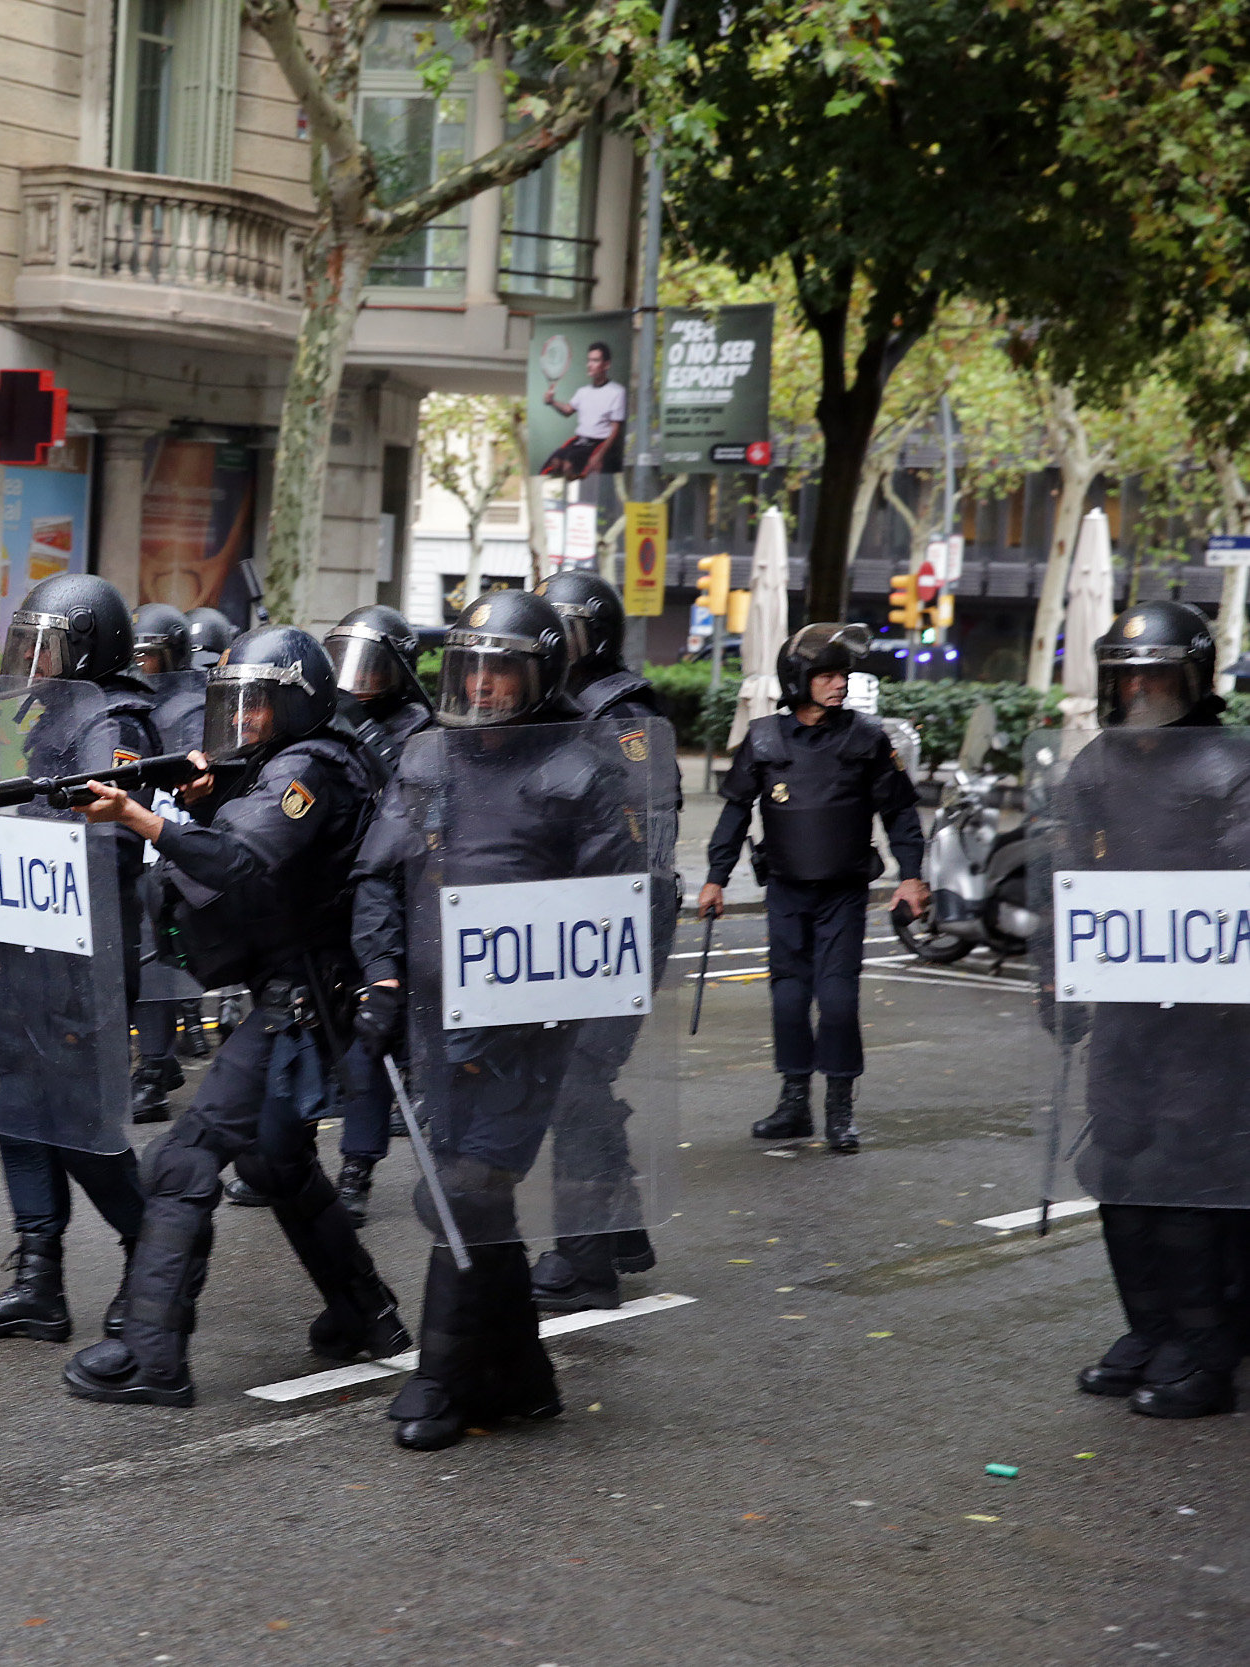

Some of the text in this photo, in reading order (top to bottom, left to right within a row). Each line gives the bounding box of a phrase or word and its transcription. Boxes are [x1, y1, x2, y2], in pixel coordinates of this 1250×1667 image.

[667, 342, 685, 366] O
[717, 339, 757, 364] SER
[459, 916, 641, 988] POLICIA
